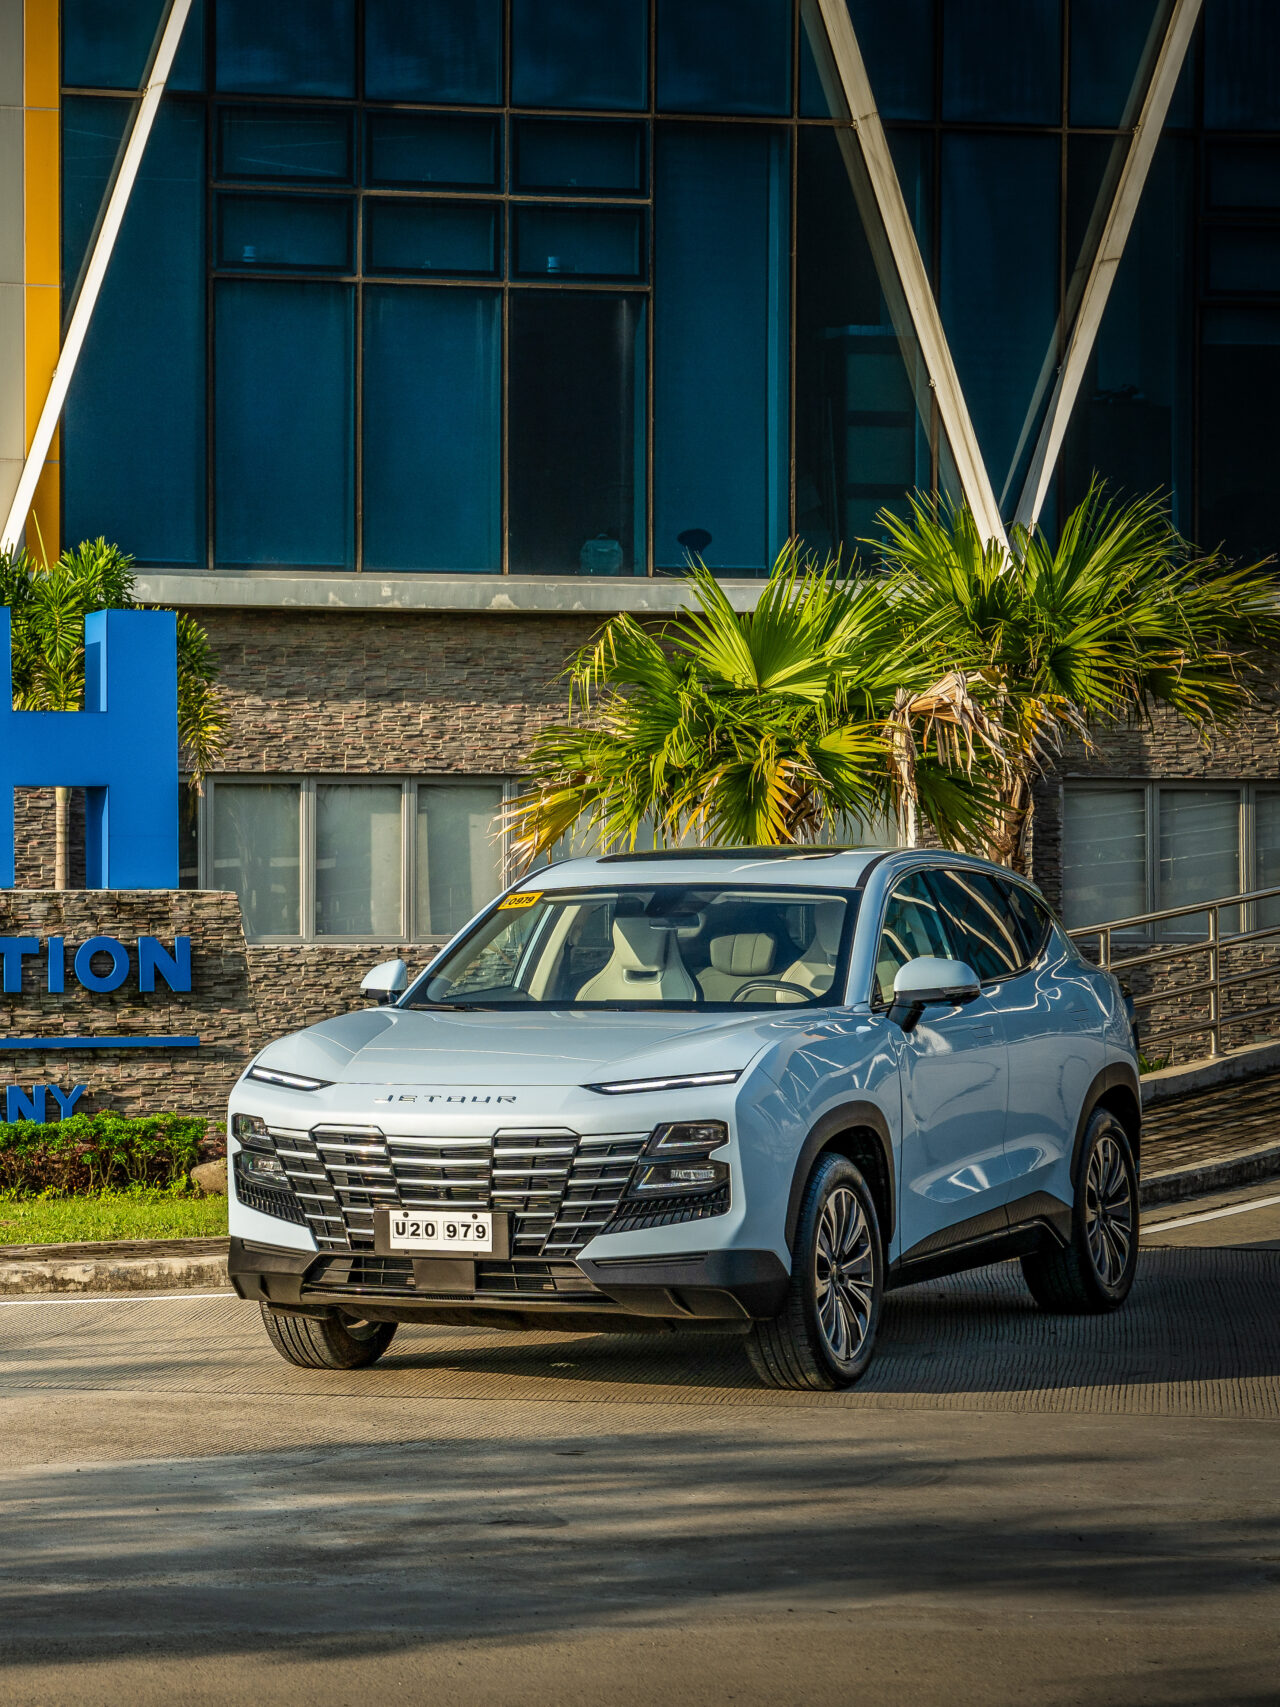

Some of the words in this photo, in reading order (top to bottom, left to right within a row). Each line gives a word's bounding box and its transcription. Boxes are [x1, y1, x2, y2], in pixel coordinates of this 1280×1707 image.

[374, 1094, 517, 1103] JETOUR
[395, 1221, 436, 1238] U20
[446, 1223, 486, 1239] 979
